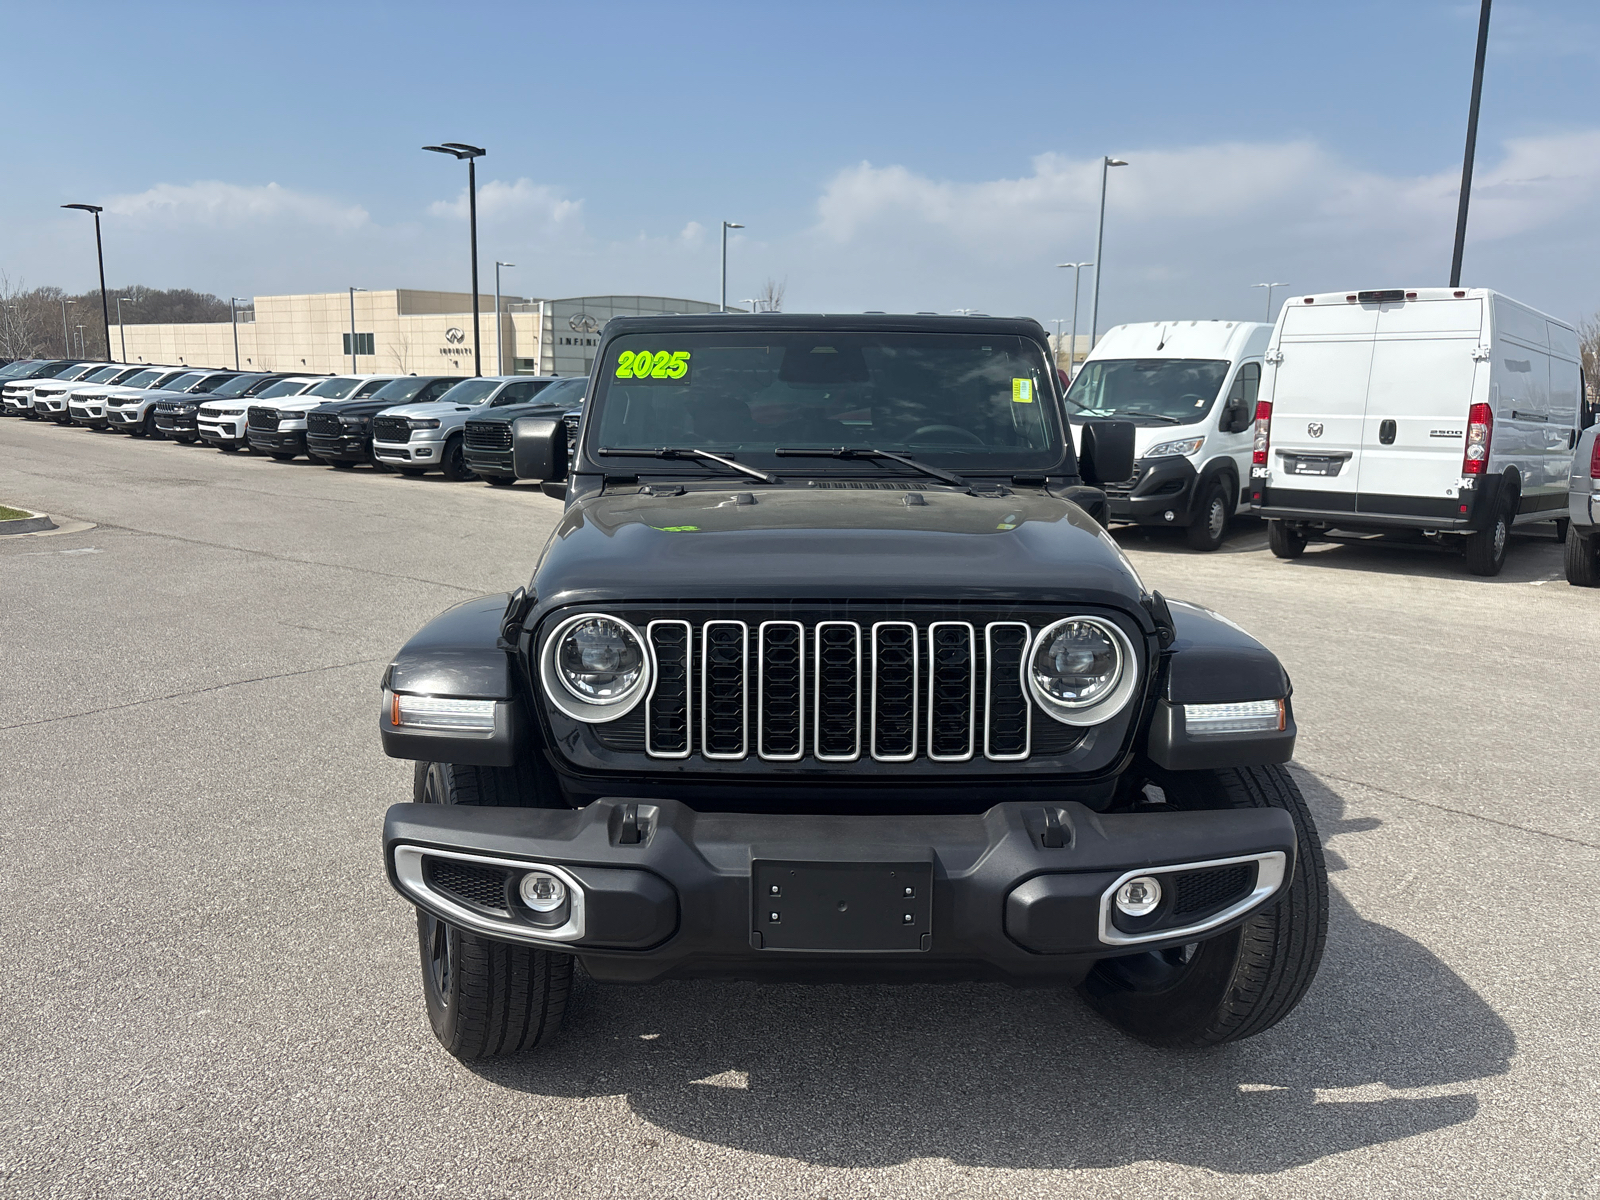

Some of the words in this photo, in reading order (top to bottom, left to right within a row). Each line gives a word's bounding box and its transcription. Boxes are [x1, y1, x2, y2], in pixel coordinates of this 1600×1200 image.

[559, 337, 600, 346] INFINI
[439, 347, 472, 355] INFINITI
[615, 350, 691, 379] 2025
